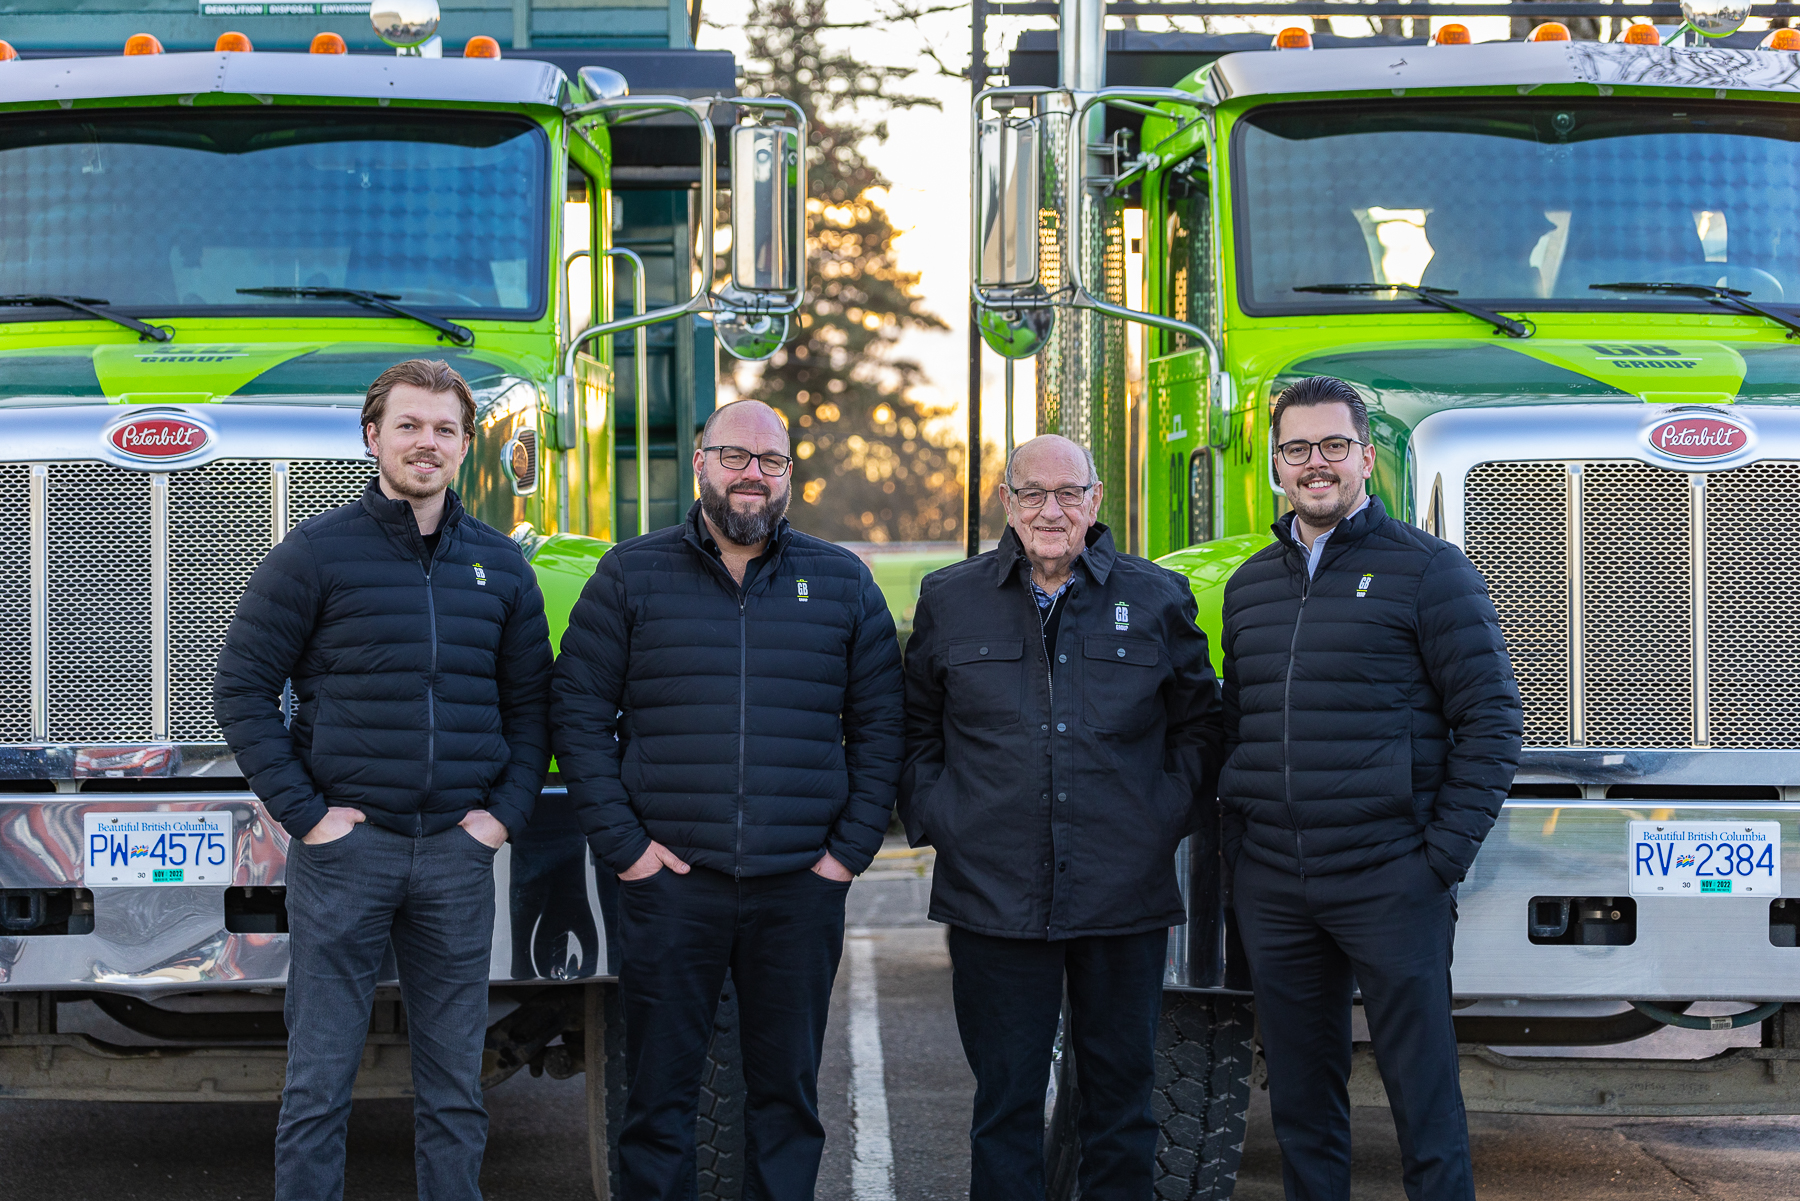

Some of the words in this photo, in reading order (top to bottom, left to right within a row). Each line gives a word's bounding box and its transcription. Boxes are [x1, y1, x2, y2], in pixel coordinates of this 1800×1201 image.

[205, 4, 263, 15] DEMOLITION
[269, 4, 315, 15] DISPOSAL
[321, 4, 370, 14] ENVIRONM
[1584, 344, 1682, 356] GB
[1612, 360, 1697, 369] GROUP
[122, 425, 199, 448] Peterbilt
[1661, 425, 1739, 448] Peterbilt
[1231, 421, 1253, 467] 113
[797, 582, 808, 596] GB
[1115, 606, 1129, 623] GB
[98, 822, 139, 832] Beautiful
[141, 821, 171, 832] British
[173, 821, 219, 832] Columbia
[1643, 831, 1685, 841] Beautiful
[1688, 831, 1718, 841] British
[1720, 831, 1766, 842] Columbia
[90, 834, 128, 867] PW
[149, 833, 225, 866] 4575
[1636, 842, 1674, 876] RV
[1695, 843, 1774, 876] 2384
[154, 870, 165, 878] NOV
[1682, 881, 1691, 889] 30
[1702, 880, 1713, 888] NOV
[1717, 880, 1731, 888] 2022
